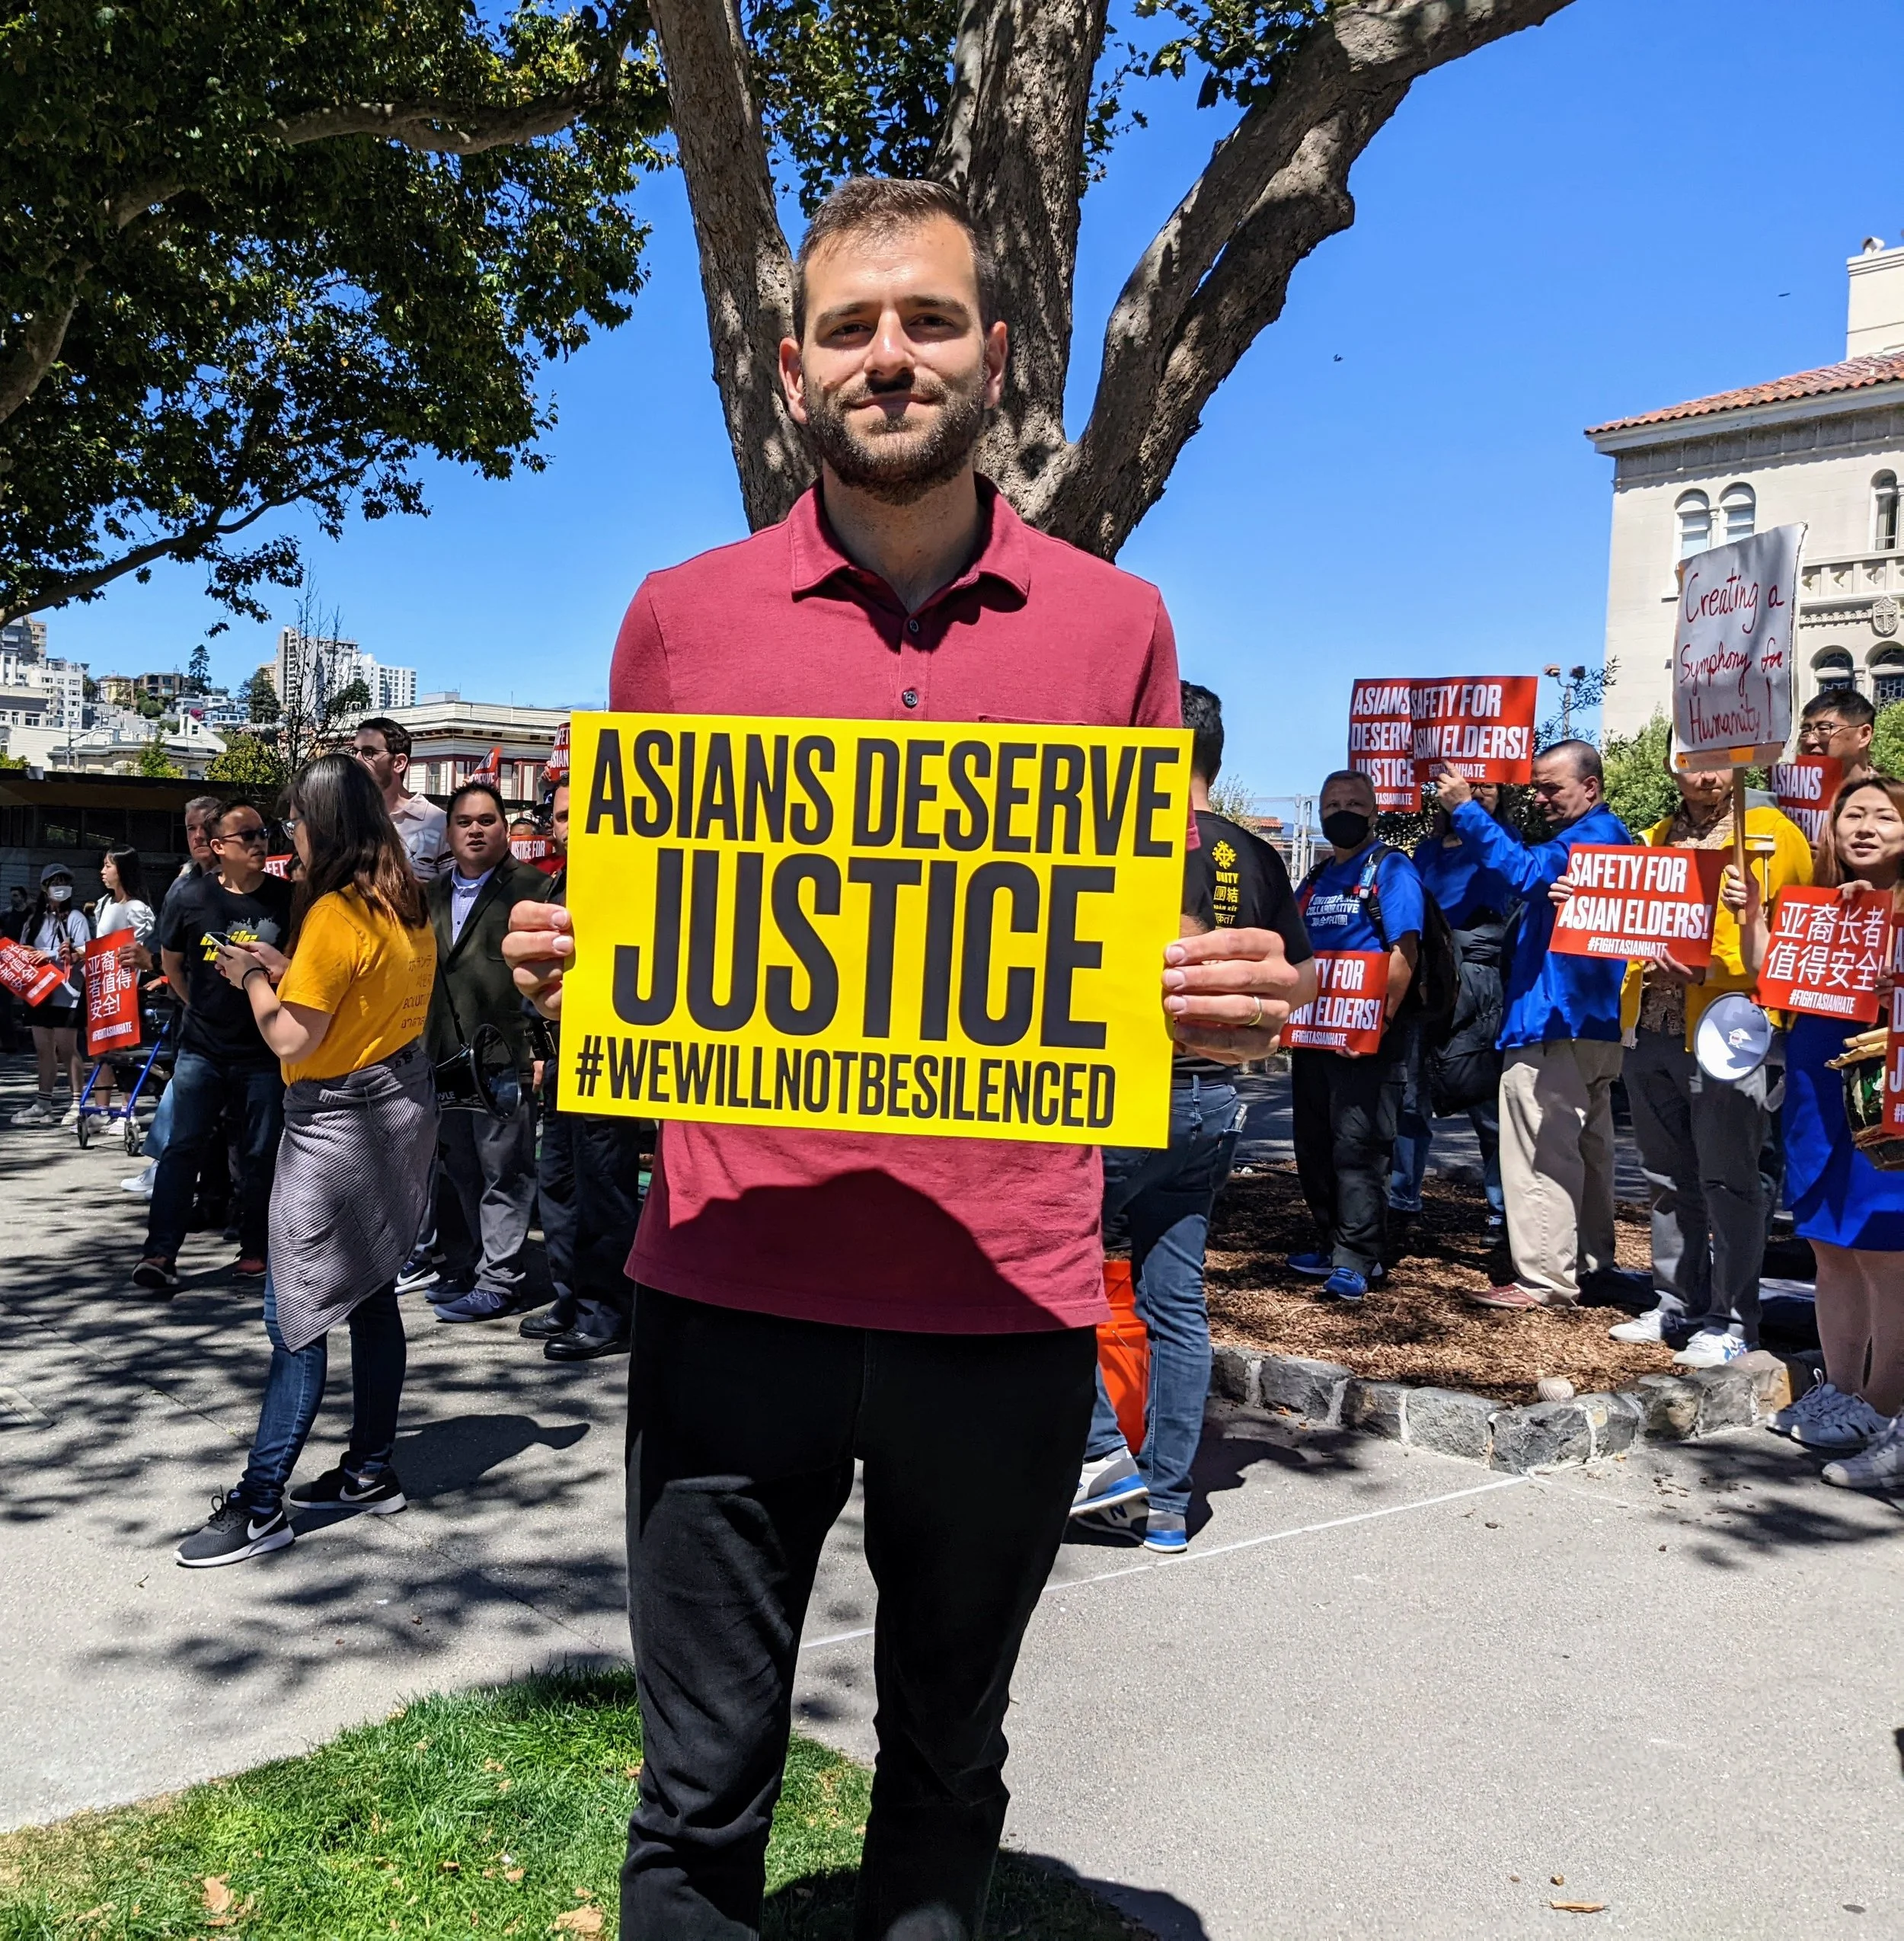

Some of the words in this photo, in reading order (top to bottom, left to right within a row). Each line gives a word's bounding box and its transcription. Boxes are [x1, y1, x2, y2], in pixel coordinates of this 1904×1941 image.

[1685, 568, 1759, 634] Creating
[1768, 584, 1784, 608] a
[1680, 641, 1752, 697] Symphony
[1761, 637, 1783, 673] for
[1352, 686, 1410, 716] ASIANS
[1410, 685, 1459, 721] SAFETY
[1458, 684, 1502, 718] FOR
[1351, 721, 1412, 751] DESERV
[1414, 726, 1441, 760] ASIAN
[1441, 725, 1530, 759] ELDERS!
[586, 729, 835, 846] ASIANS
[851, 737, 1180, 859] DESERVE
[1771, 763, 1823, 801] ASIANS
[532, 839, 546, 859] FOR
[1216, 871, 1239, 884] UNITY
[1568, 852, 1644, 891] SAFETY
[1644, 855, 1688, 894] FOR
[1557, 895, 1622, 933] ASIAN
[1623, 899, 1713, 940] ELDERS!
[1775, 901, 1885, 948] 亚裔长者
[88, 948, 121, 977] 亚裔
[612, 847, 1116, 1050] JUSTICE
[1331, 958, 1366, 991] FOR
[1315, 996, 1381, 1031] ELDERS!
[575, 1034, 1116, 1129] #WEWILLNOTBESILENCED
